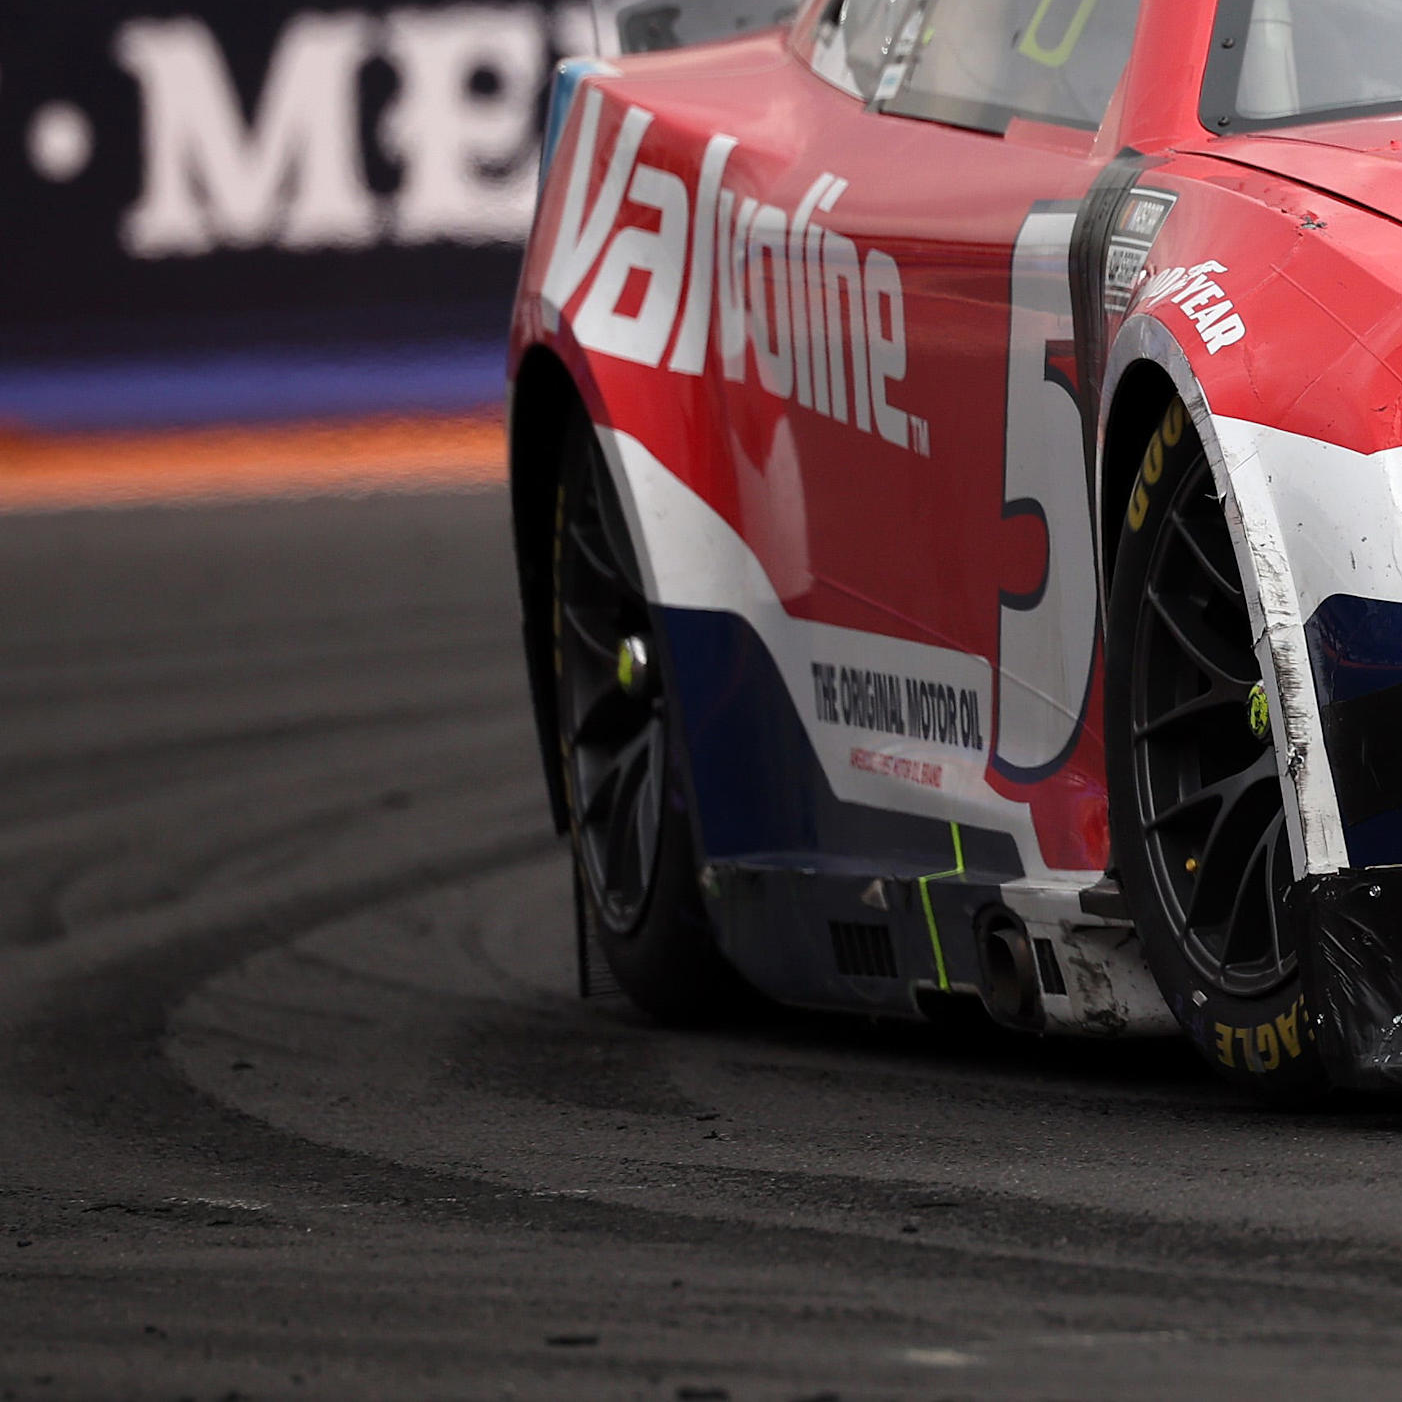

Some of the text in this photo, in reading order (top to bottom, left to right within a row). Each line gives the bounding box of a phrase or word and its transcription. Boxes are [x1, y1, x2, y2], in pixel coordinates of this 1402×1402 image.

[541, 87, 914, 449] Valvoline
[811, 662, 983, 751] THE ORIGINAL MOTOR OIL
